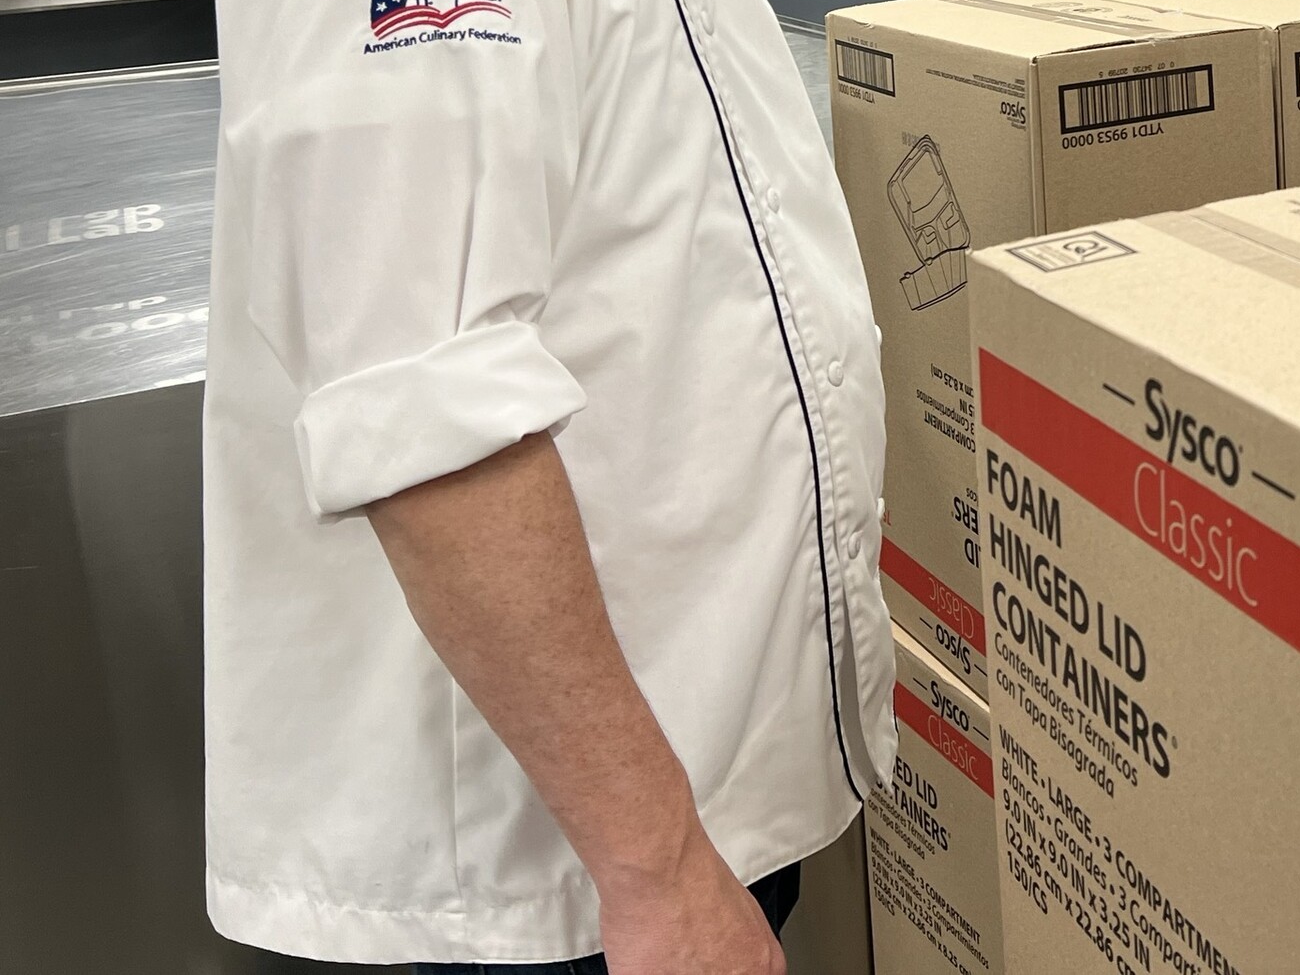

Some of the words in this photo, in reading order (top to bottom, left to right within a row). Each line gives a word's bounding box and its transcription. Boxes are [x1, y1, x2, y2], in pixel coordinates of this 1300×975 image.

[363, 36, 418, 54] American
[419, 29, 466, 43] Culinary
[468, 28, 522, 44] Federation
[999, 101, 1027, 125] Sysco
[924, 409, 976, 454] COMPARTMENT
[1144, 378, 1243, 489] Sysco
[985, 448, 1063, 550] FOAM
[1134, 461, 1259, 607] Classic
[964, 537, 981, 569] ID
[928, 576, 975, 640] Classic
[988, 512, 1090, 636] HINGED
[1097, 600, 1147, 683] LID
[934, 624, 972, 675] Sysco
[992, 581, 1171, 779] CONTAINERS
[930, 680, 971, 732] Sysco
[994, 631, 1076, 727] Contenedores
[1076, 708, 1139, 788] Térmicos
[996, 668, 1016, 698] con
[1016, 680, 1048, 734] Tapa
[1049, 715, 1115, 800] Bisagrada
[927, 713, 980, 782] Classic
[870, 787, 907, 828] ontenedores
[889, 780, 950, 852] TAINERS
[915, 772, 938, 810] LID
[998, 723, 1039, 788] WHITE
[1048, 776, 1093, 845] LARGE
[1103, 835, 1113, 864] 3
[1001, 757, 1045, 821] Blancos
[1054, 815, 1107, 891] Grandes
[1118, 885, 1127, 912] 3
[869, 826, 890, 855] WHITE
[893, 851, 916, 882] LARGE
[925, 883, 981, 945] COMPARTMENT
[1002, 788, 1022, 825] 9.0
[1022, 809, 1037, 842] IN
[1038, 833, 1047, 858] x
[1048, 839, 1069, 879] 9.0
[1070, 861, 1086, 900] IN
[1087, 888, 1097, 914] x
[1098, 898, 1131, 949] 3.25
[1132, 929, 1151, 974] IN
[1005, 818, 1042, 878] (22.86
[1043, 869, 1063, 903] cm
[1064, 892, 1074, 918] x
[1075, 900, 1115, 964] 22.86
[1006, 850, 1049, 915] 150/CS
[932, 905, 989, 970] Compartimientos
